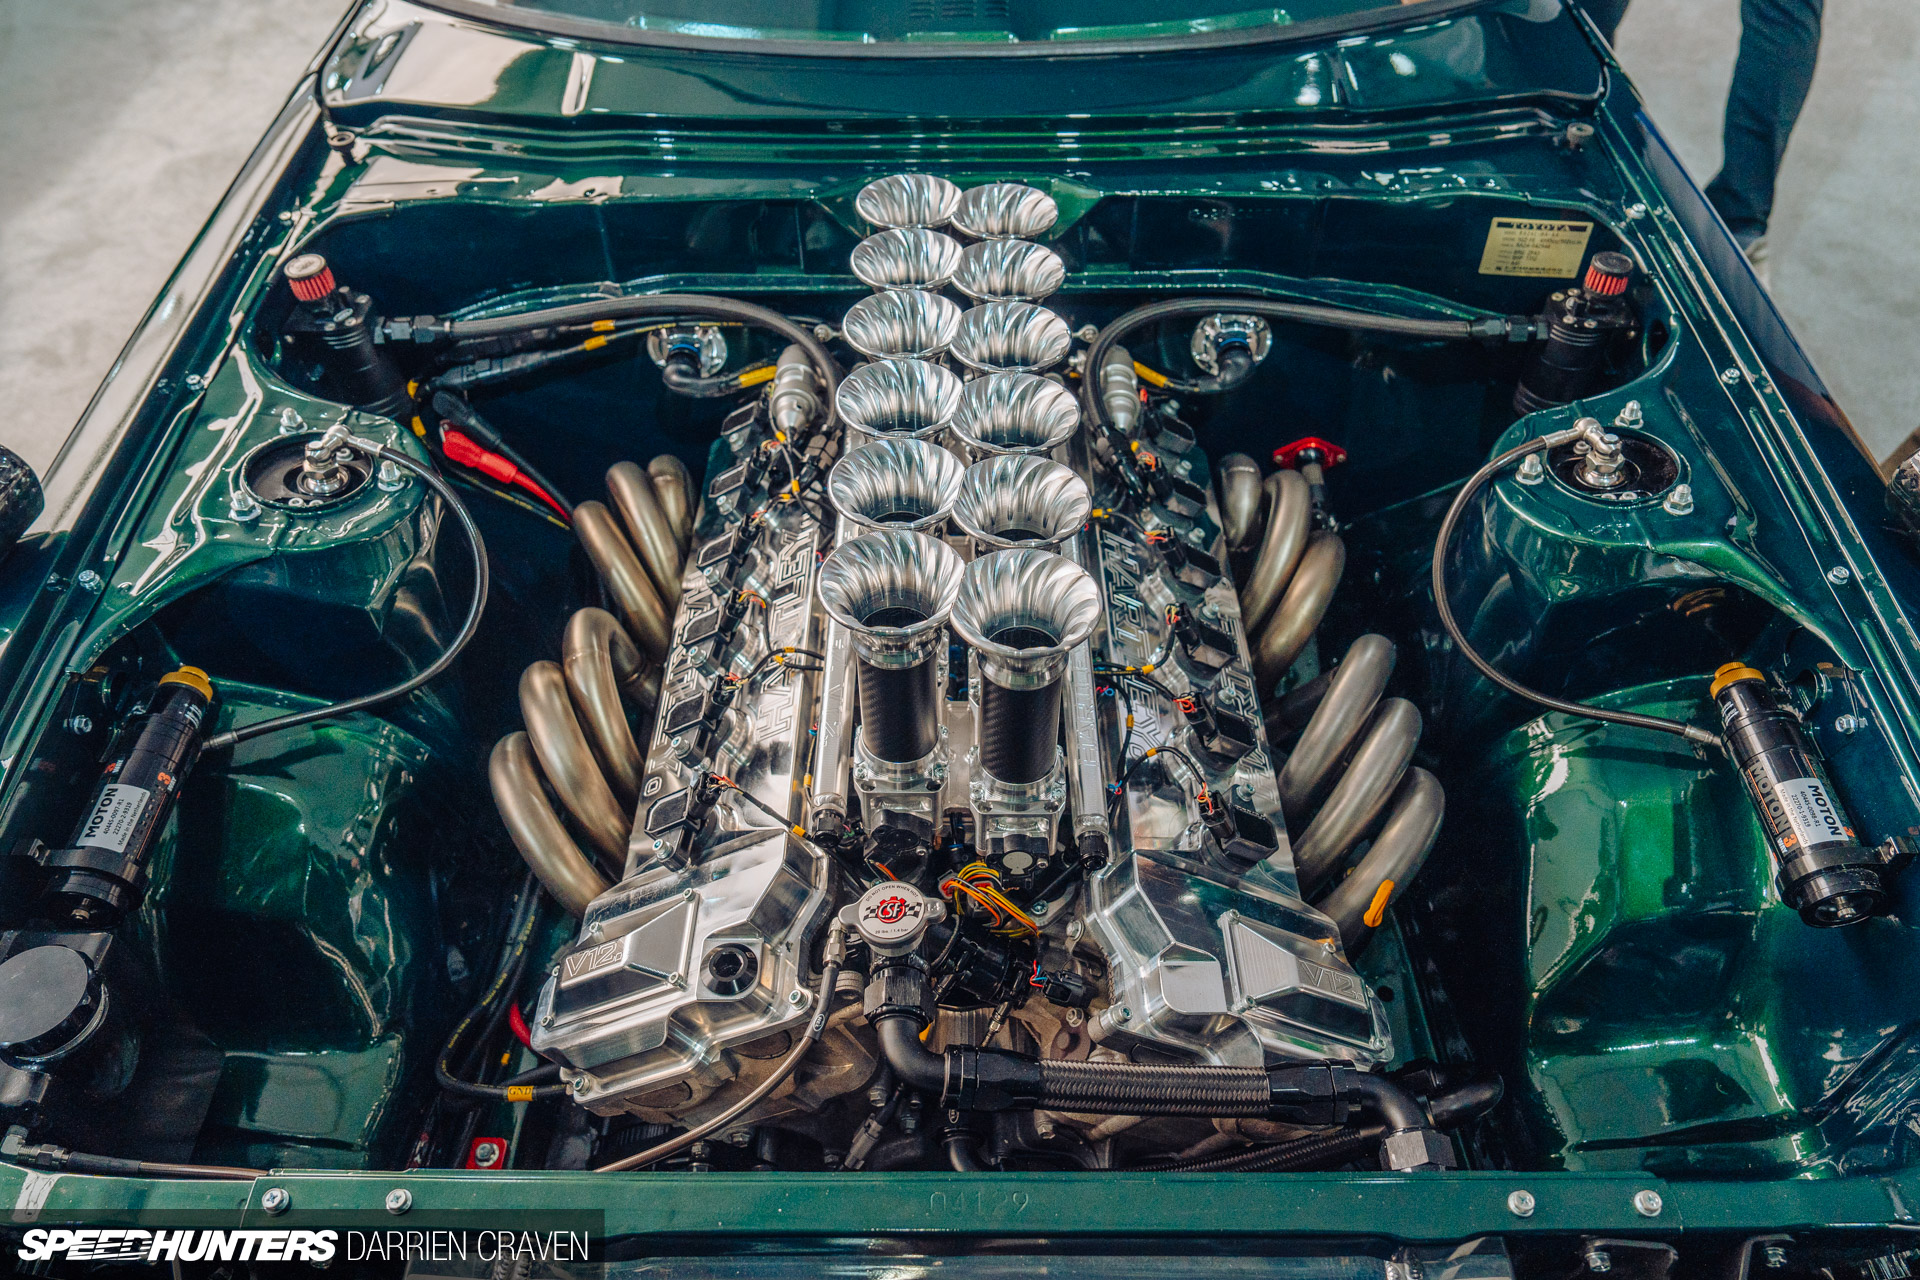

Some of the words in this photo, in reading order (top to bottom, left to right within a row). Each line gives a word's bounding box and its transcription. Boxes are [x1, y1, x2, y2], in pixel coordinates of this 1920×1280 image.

[1511, 223, 1571, 231] TOYOTA
[157, 772, 171, 785] 3
[1750, 762, 1791, 832] MOTON
[84, 788, 119, 838] MOTON
[117, 831, 127, 846] Made
[131, 791, 147, 819] Netherlands
[1808, 785, 1842, 836] MOTON
[1777, 837, 1788, 854] WAY
[1783, 834, 1797, 848] 3
[878, 902, 902, 918] CSF
[508, 1086, 532, 1096] GND
